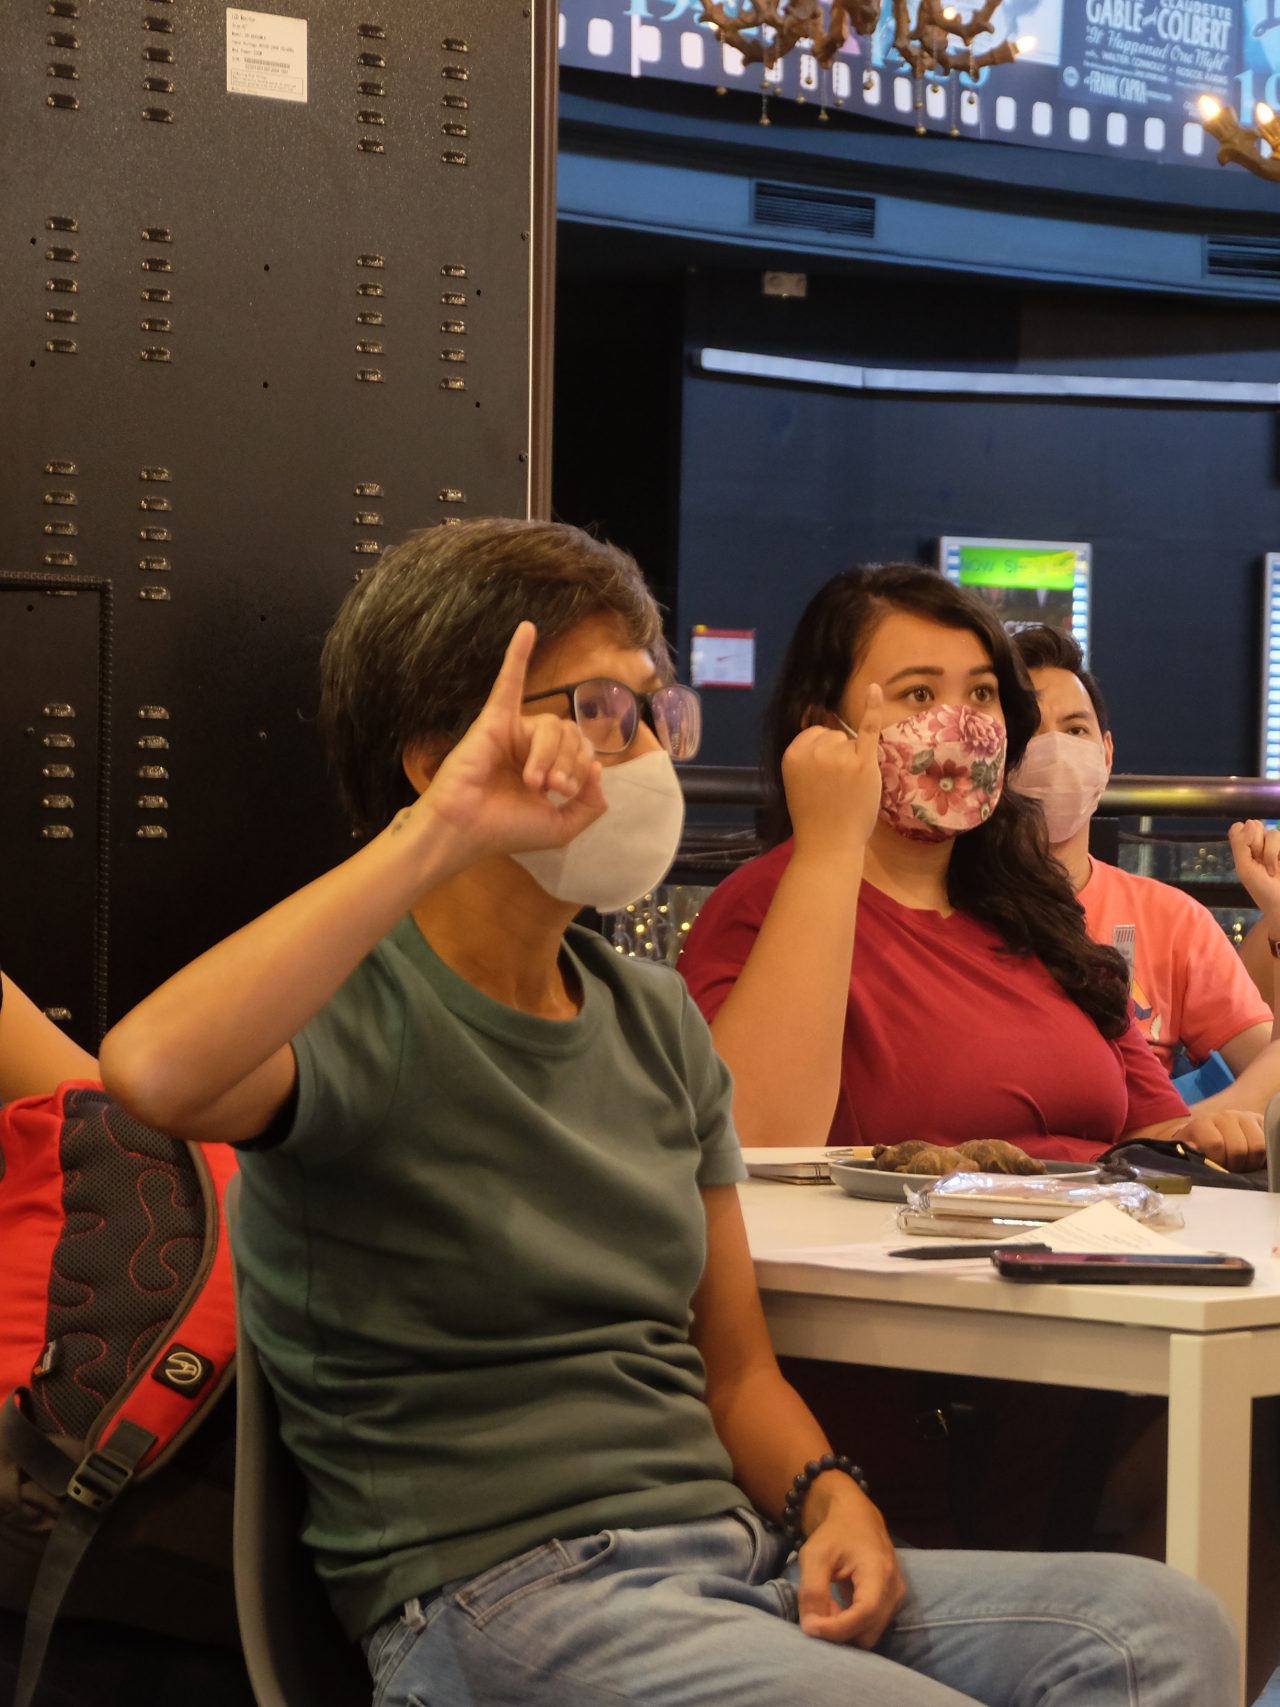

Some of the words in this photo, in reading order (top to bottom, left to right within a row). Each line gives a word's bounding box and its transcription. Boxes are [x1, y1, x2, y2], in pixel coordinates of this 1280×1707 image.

[1086, 0, 1145, 32] GABLE
[1159, 0, 1232, 20] CLAUDETTE
[1156, 8, 1232, 51] COLBERT
[1107, 29, 1169, 58] Happened
[1170, 45, 1193, 64] One
[1089, 70, 1119, 98] FRANK
